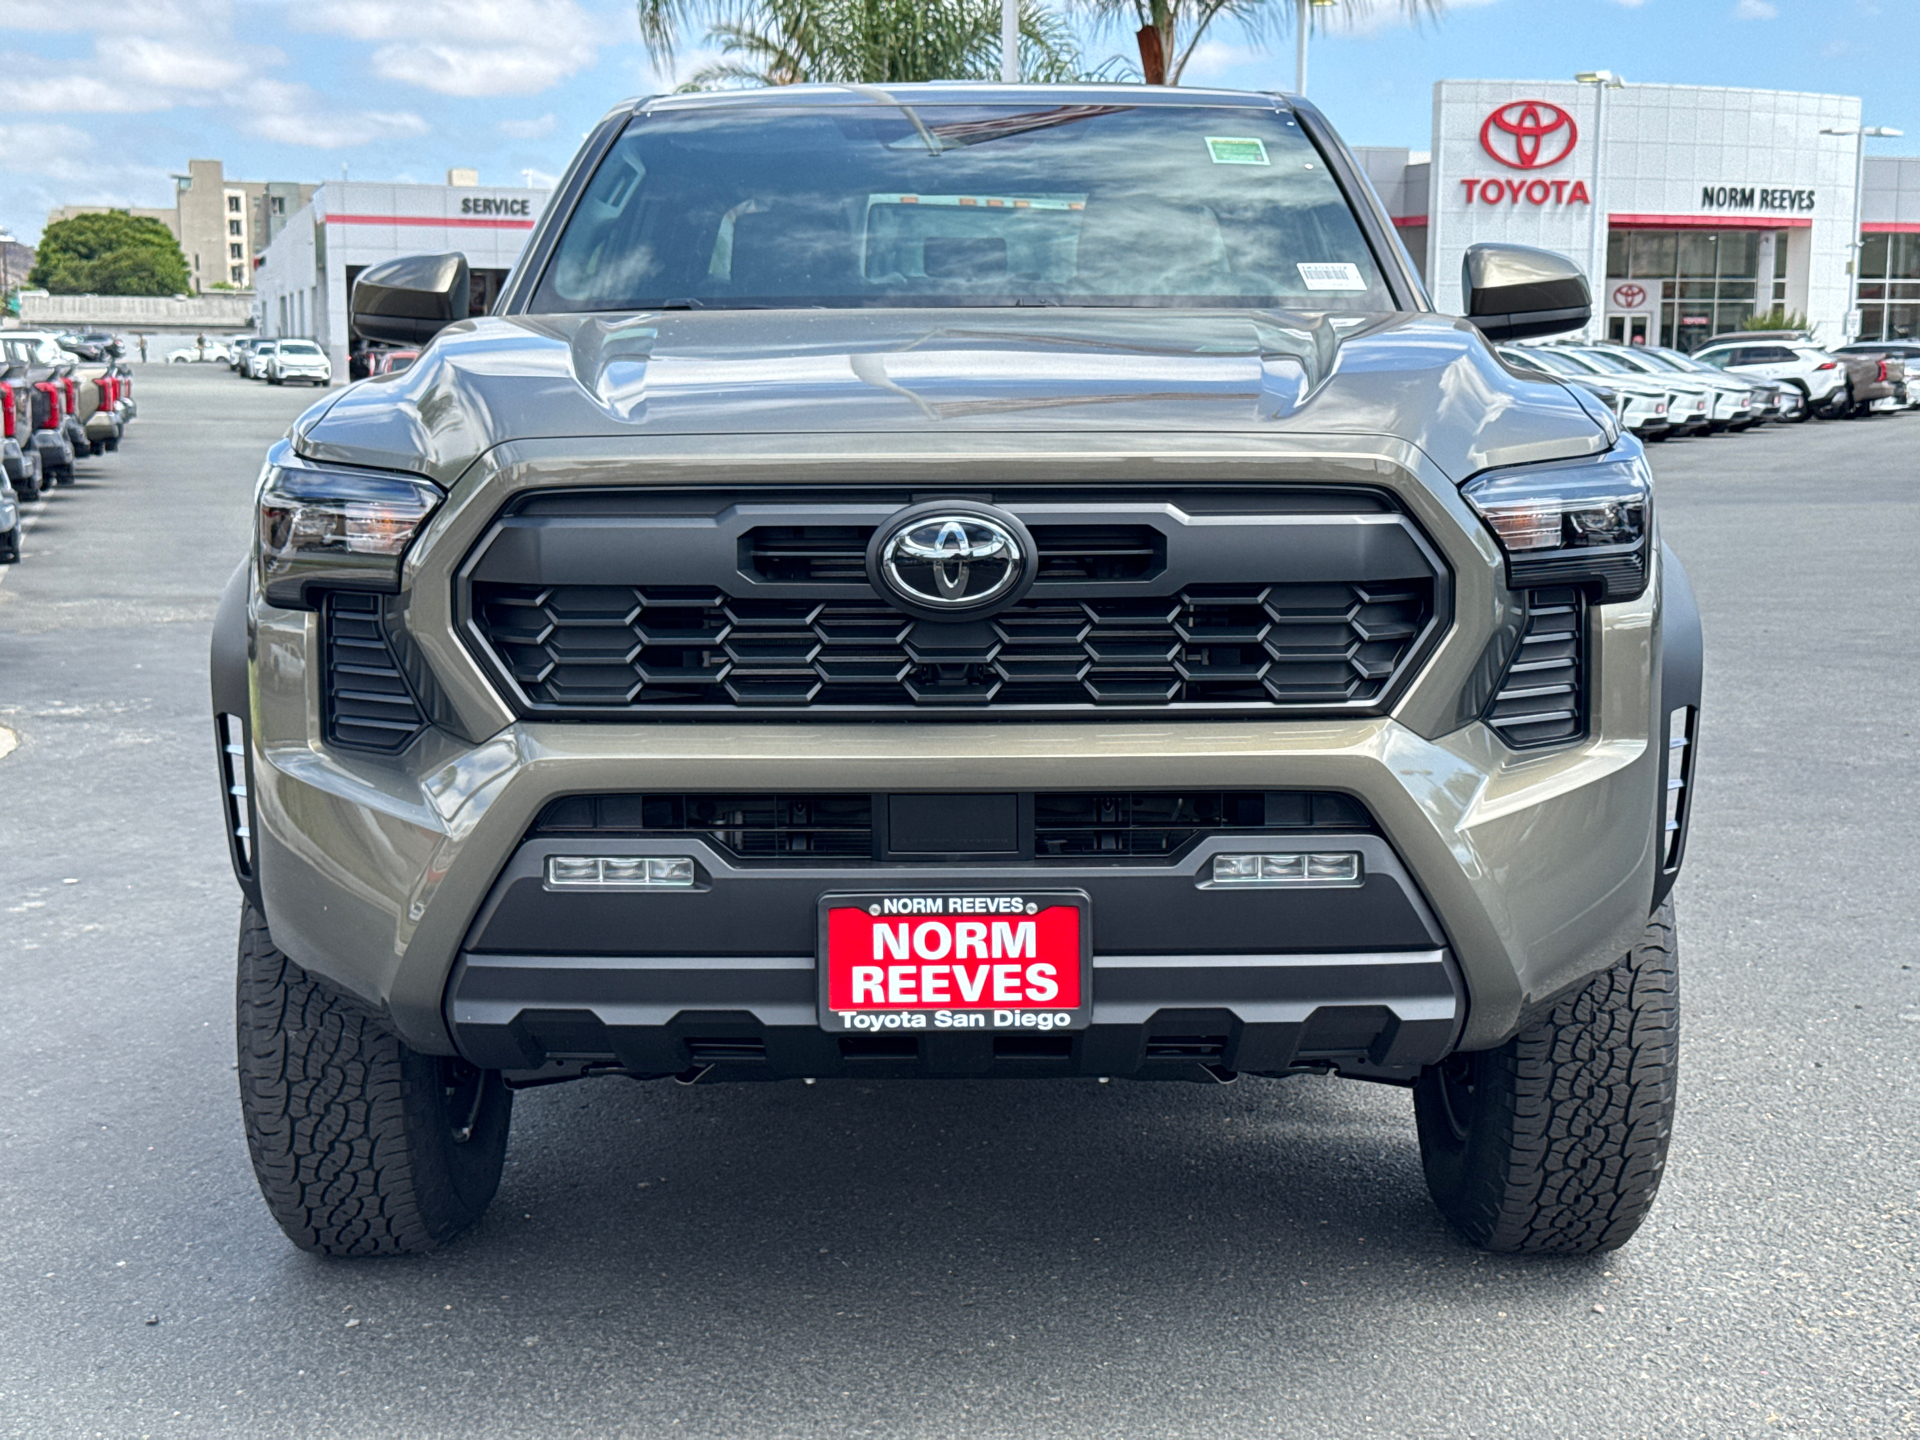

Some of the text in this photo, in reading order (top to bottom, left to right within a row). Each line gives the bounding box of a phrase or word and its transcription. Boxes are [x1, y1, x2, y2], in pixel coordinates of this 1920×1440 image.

[1460, 179, 1591, 206] TOYOTA
[1702, 186, 1816, 211] NORM REEVES
[461, 197, 531, 216] SERVICE
[883, 897, 1024, 914] NORM REEVES
[872, 921, 1037, 960] NORM
[851, 963, 1059, 1003] REEVES
[838, 1009, 1071, 1032] Toyota San Diego
